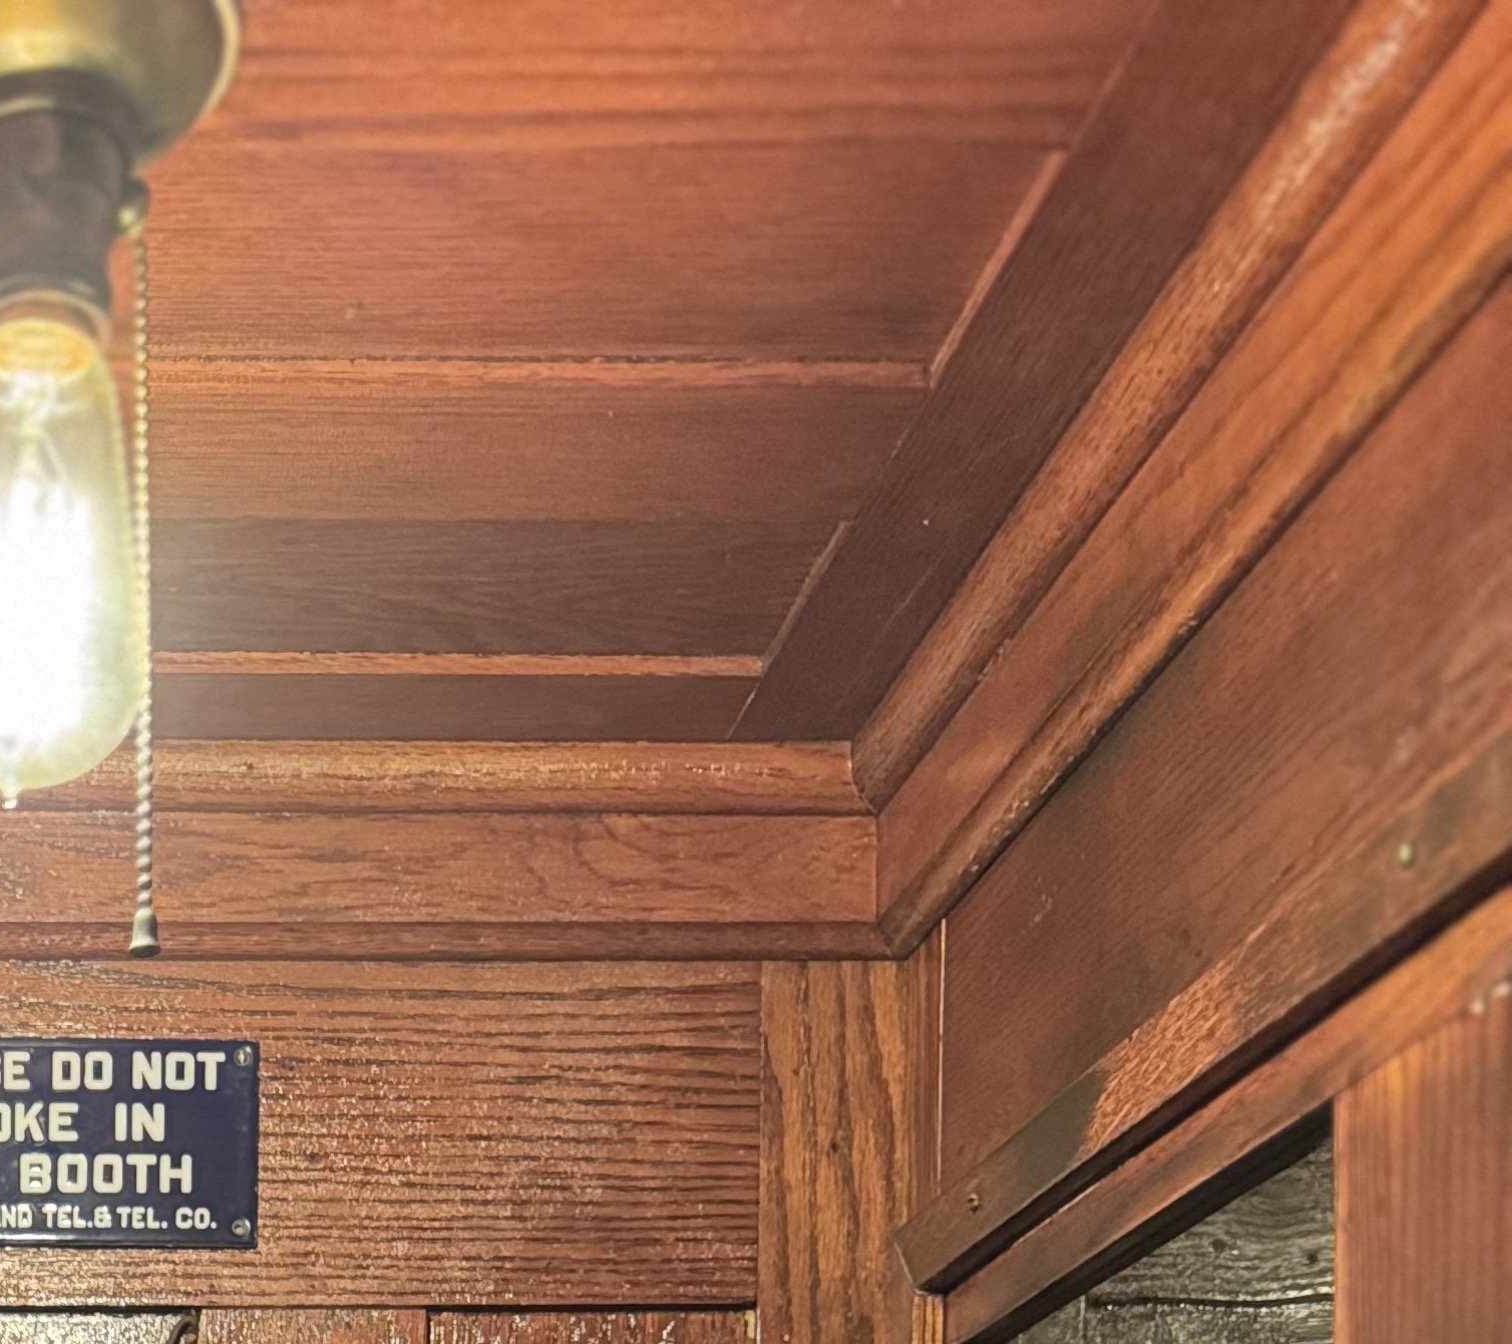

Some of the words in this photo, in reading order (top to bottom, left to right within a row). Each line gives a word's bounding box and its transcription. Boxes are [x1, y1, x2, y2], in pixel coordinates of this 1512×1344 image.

[51, 1051, 113, 1091] DO
[131, 1051, 226, 1091] NOT
[114, 1102, 165, 1142] IN
[19, 1153, 193, 1194] BOOTH
[116, 1206, 168, 1229] TEL.
[175, 1206, 218, 1229] CO.
